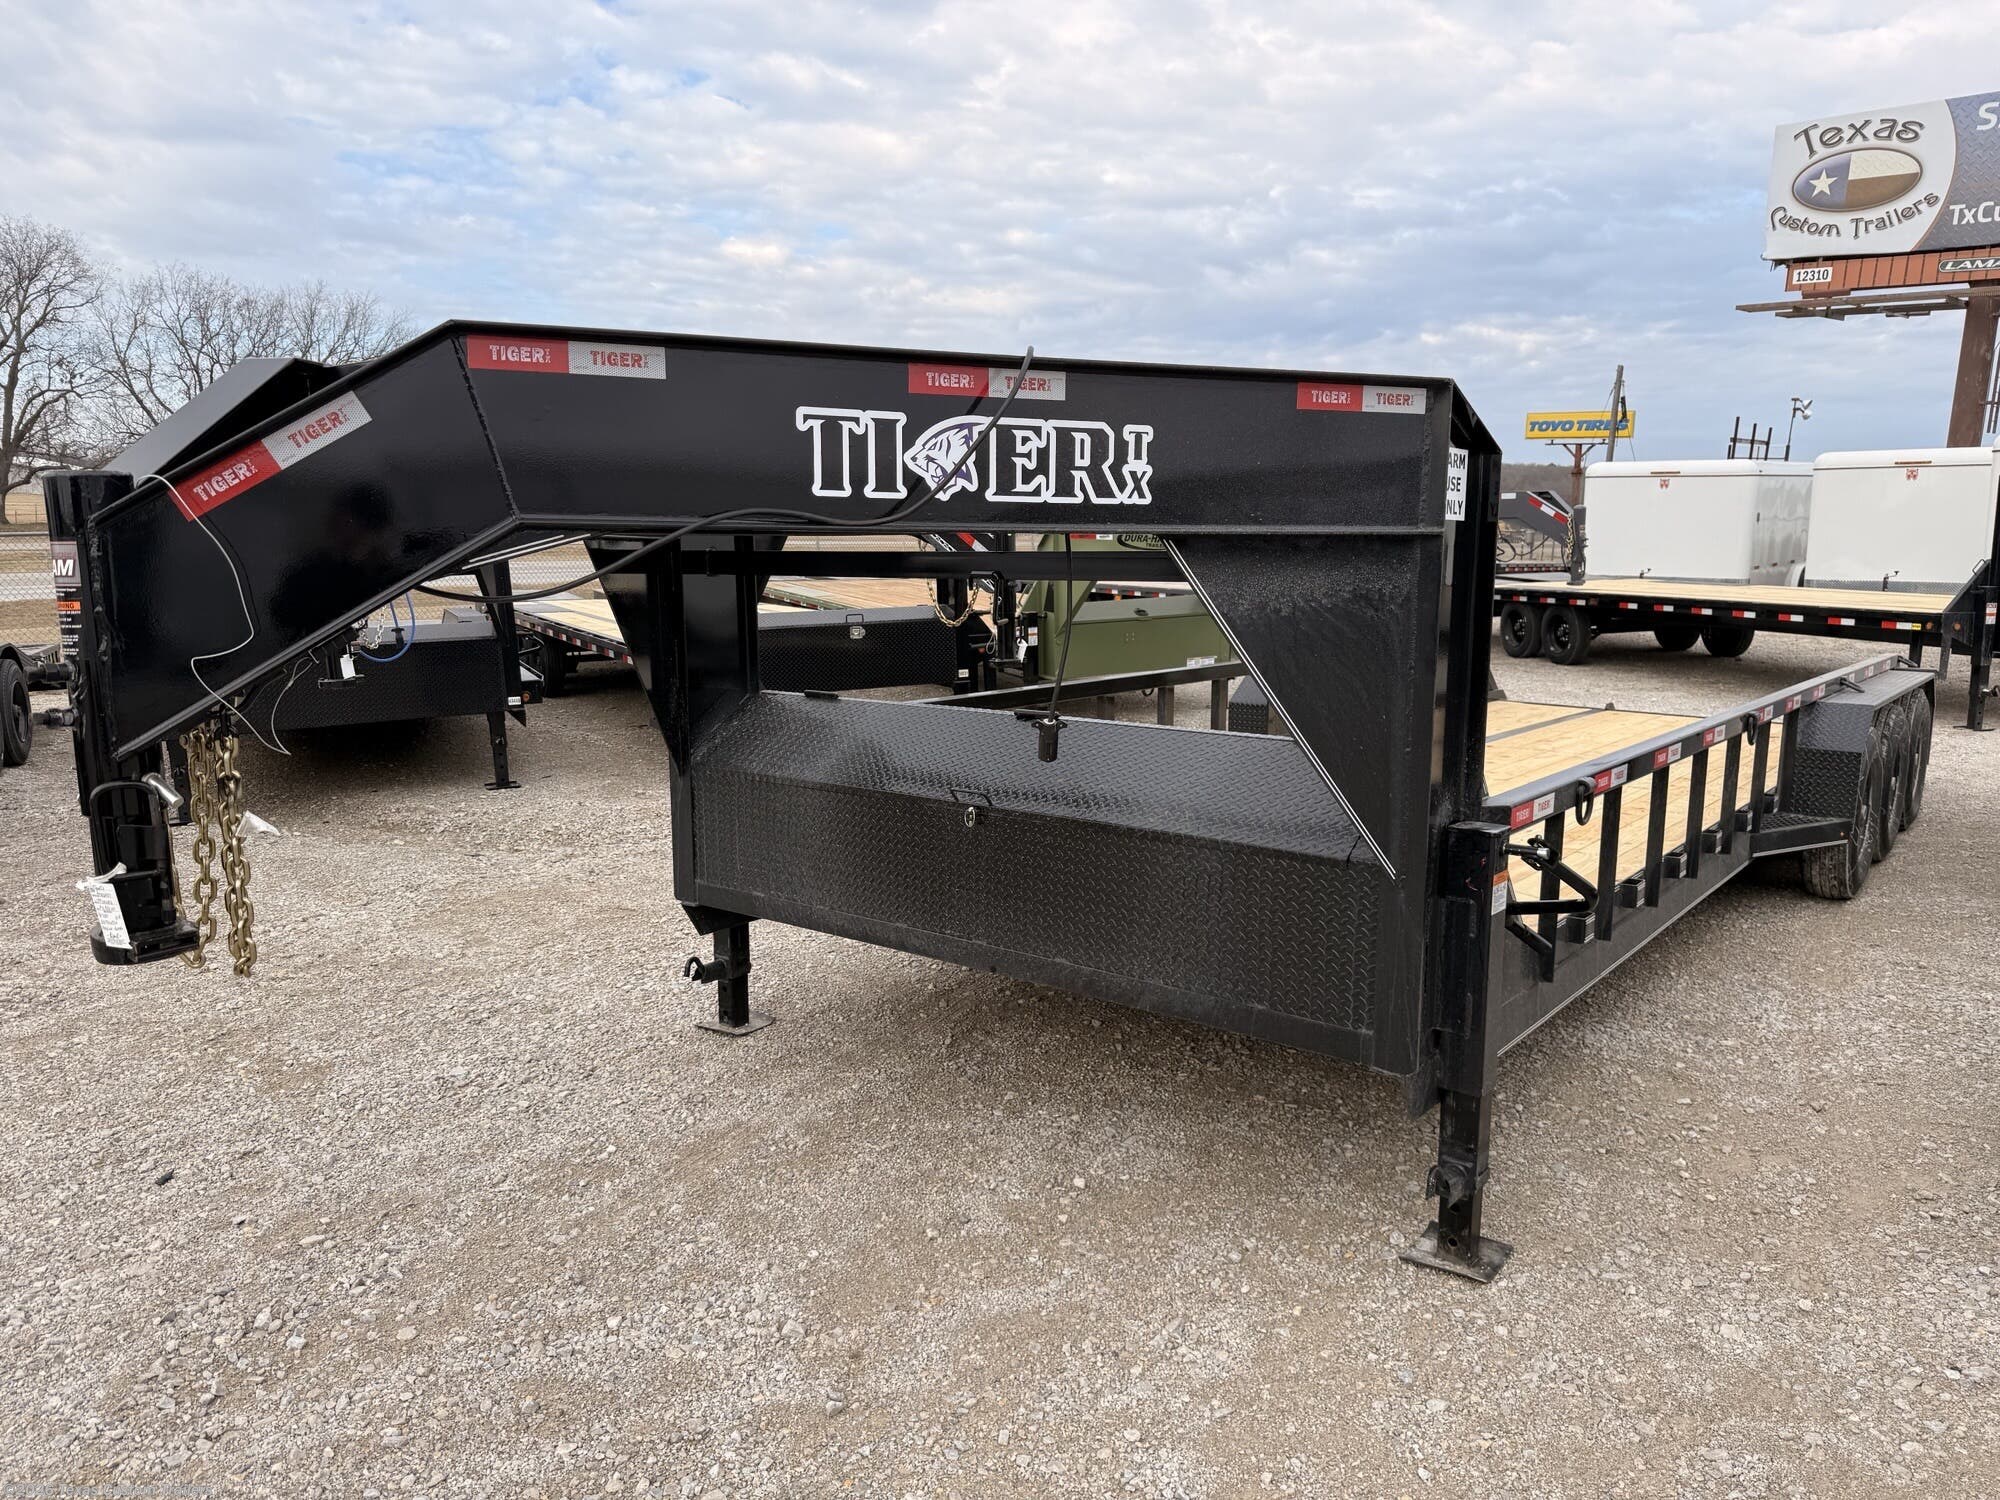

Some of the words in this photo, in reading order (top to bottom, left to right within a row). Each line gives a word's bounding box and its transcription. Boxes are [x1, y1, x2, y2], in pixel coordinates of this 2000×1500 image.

[1976, 101, 2000, 130] S
[1793, 117, 1925, 159] Texas
[1770, 206, 1842, 237] Custom
[1850, 192, 1940, 240] Trailers
[1796, 268, 1829, 282] 12310
[489, 344, 544, 364] TIGER
[589, 350, 642, 369] TIGER
[926, 371, 970, 388] TIGER
[1311, 390, 1347, 404] TIGER
[1376, 392, 1411, 406] TIGER
[288, 411, 345, 449] TIGER
[1529, 420, 1575, 432] TOYO
[1576, 418, 1629, 431] TIRES
[193, 461, 253, 502] TIGER
